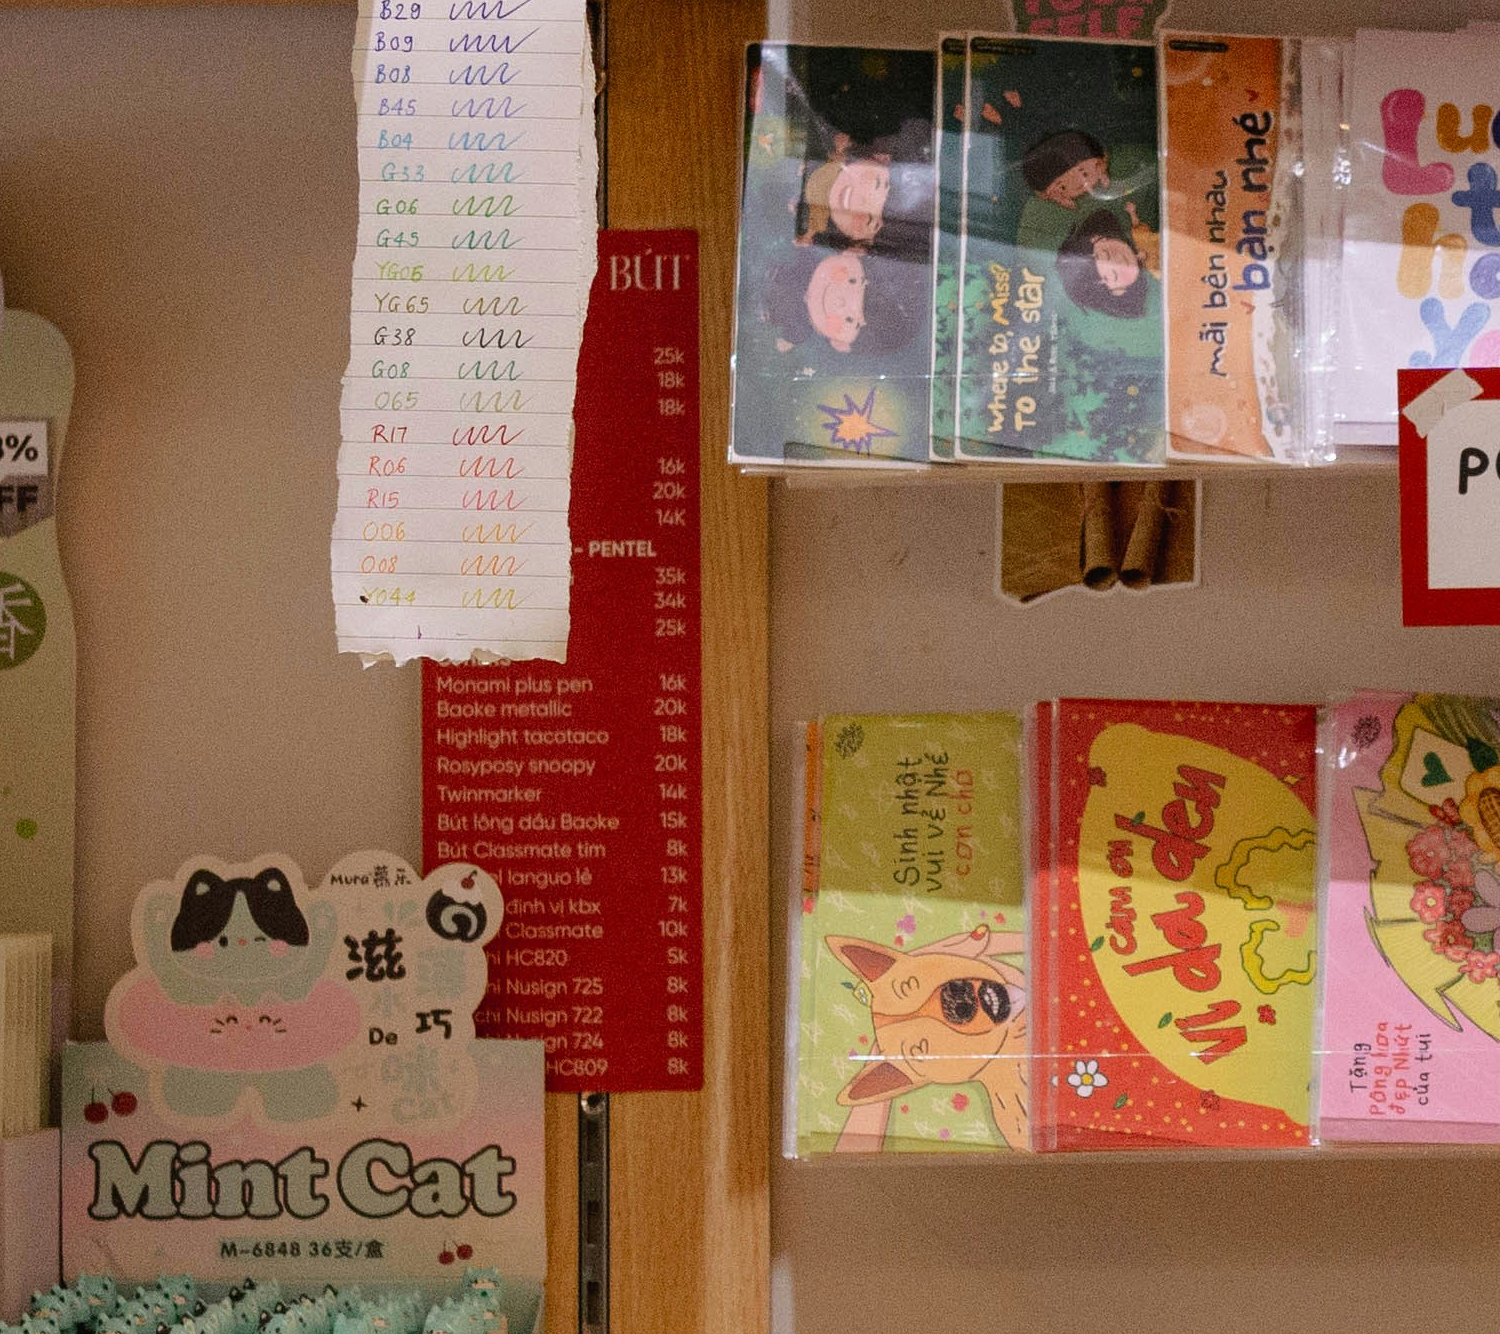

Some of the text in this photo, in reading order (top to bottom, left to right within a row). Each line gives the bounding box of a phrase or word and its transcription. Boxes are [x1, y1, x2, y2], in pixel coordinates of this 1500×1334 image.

[373, 30, 414, 54] B09
[376, 196, 420, 217] G06
[1204, 170, 1230, 244] nhau
[1232, 110, 1276, 292] bạn nhé
[1201, 253, 1229, 309] bên
[1013, 267, 1046, 324] star
[373, 326, 418, 348] G38
[653, 347, 685, 365] 25k
[370, 359, 411, 380] G08
[657, 372, 685, 389] 18k
[657, 399, 685, 417] 18k
[370, 424, 409, 444] R17
[367, 456, 407, 476] R06
[658, 458, 686, 475] 16k
[366, 487, 401, 510] R15
[652, 482, 686, 501] 20k
[588, 540, 658, 559] PENTEL
[655, 567, 687, 586] 35k
[655, 593, 687, 611] 34k
[655, 619, 687, 638] 25k
[435, 674, 688, 698] Monami plus pen 16k
[435, 698, 689, 719] Baoke metallic 20k
[435, 726, 689, 749] Highlight tacotaco 18k
[435, 754, 689, 778] Rosyposy snoopy 20k
[436, 784, 689, 803] Twinmarker 14k
[436, 811, 471, 832] Bút
[473, 811, 513, 835] lông
[559, 812, 620, 832] Baoke
[658, 811, 689, 830] 15k
[436, 838, 471, 859] Bút
[473, 839, 573, 859] Classmate
[665, 838, 689, 857] 8k
[893, 827, 921, 887] Sinh
[329, 873, 371, 886] Mura
[658, 868, 689, 887] 13k
[921, 850, 946, 892] vui
[667, 896, 689, 914] 7k
[505, 920, 689, 940] Classmate 10k
[505, 947, 689, 968] HC820 5k
[505, 976, 689, 999] Nusign 725 8k
[505, 1004, 689, 1028] Nusign 722 8k
[572, 1031, 689, 1050] 724 8k
[665, 1057, 689, 1076] 8k
[1349, 1042, 1372, 1094] Tặng
[1412, 1033, 1433, 1106] của tui
[87, 1137, 518, 1221] Mint Cat
[219, 1240, 301, 1259] M-6848
